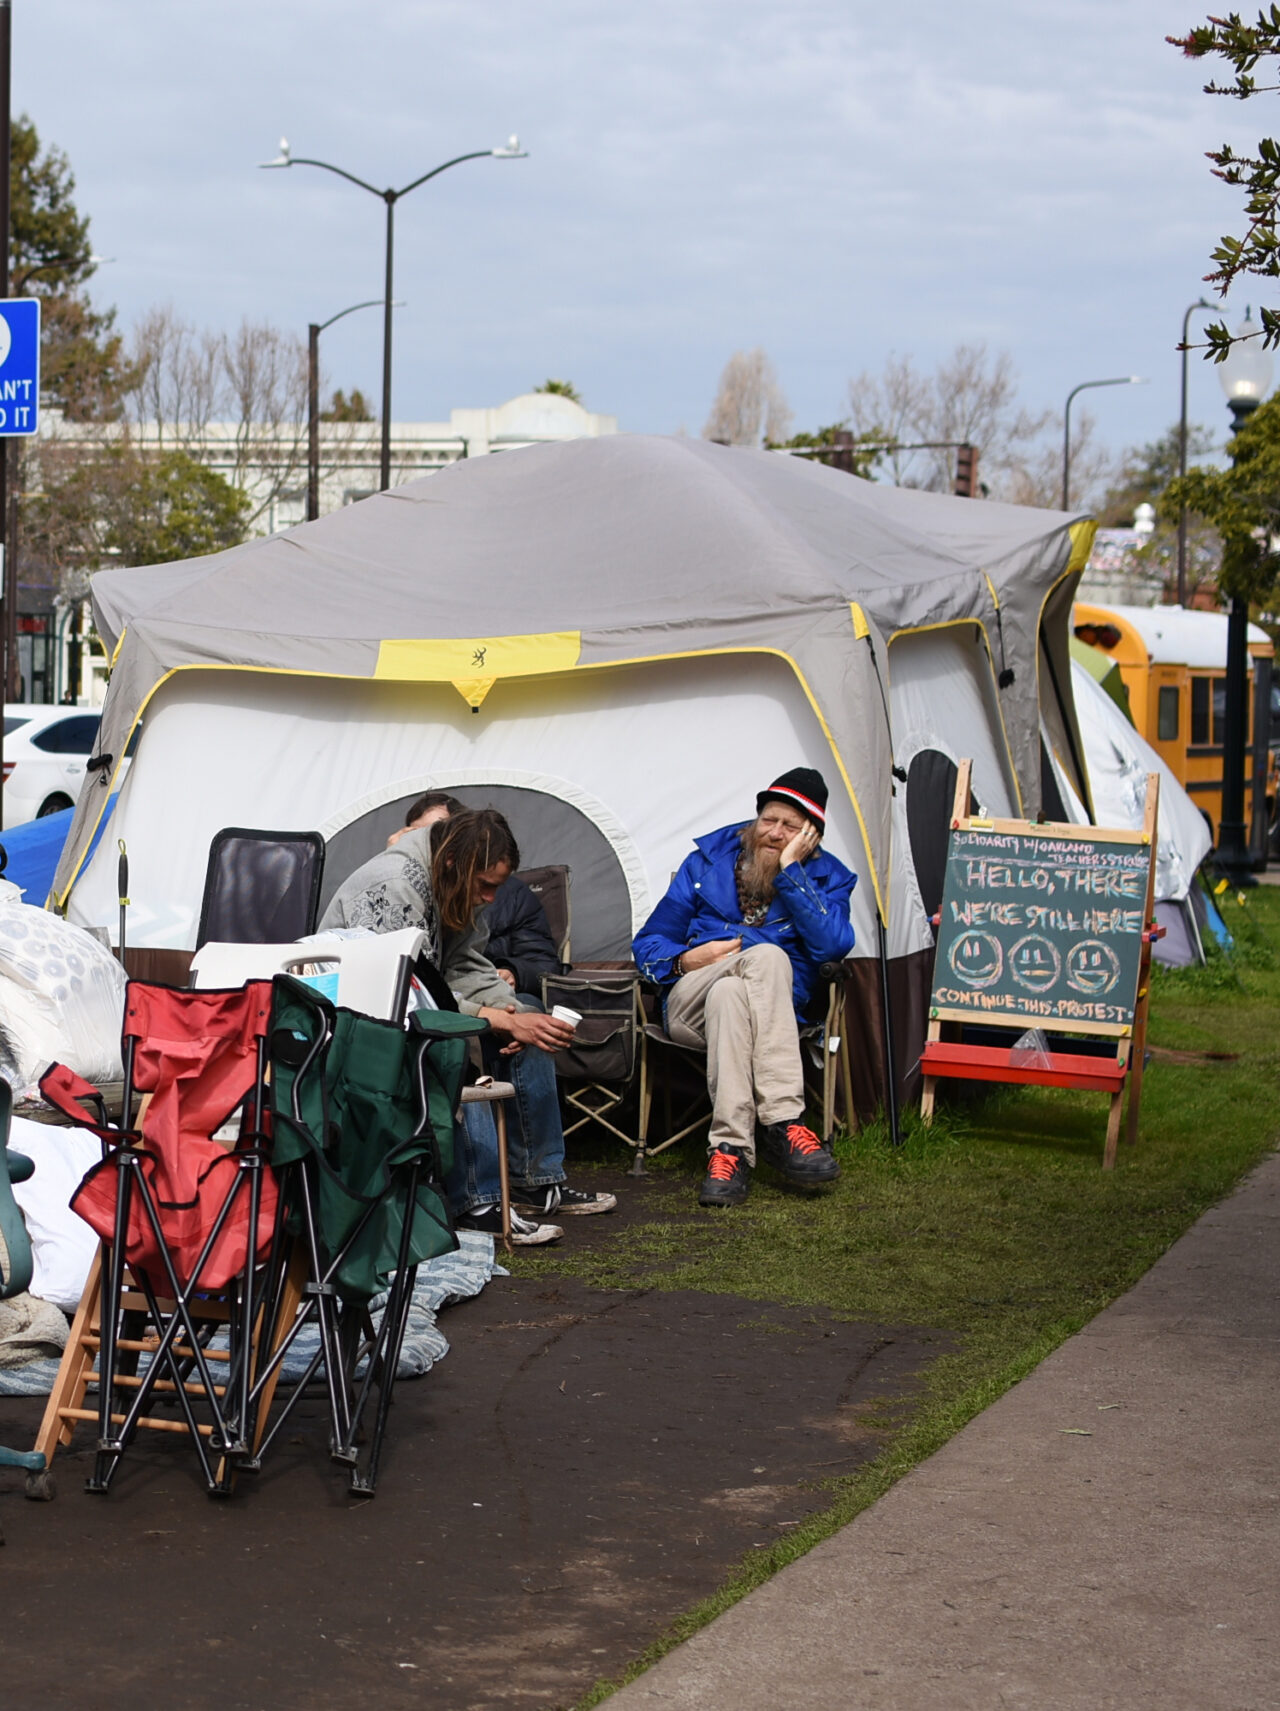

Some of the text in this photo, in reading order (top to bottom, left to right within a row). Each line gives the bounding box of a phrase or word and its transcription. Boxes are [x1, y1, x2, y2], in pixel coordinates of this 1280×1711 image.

[15, 406, 30, 428] IT
[953, 832, 1019, 854] SOLIDARITY
[966, 861, 1142, 899] HELLO, THERE
[950, 900, 1143, 936] WE'RE STILL HERE
